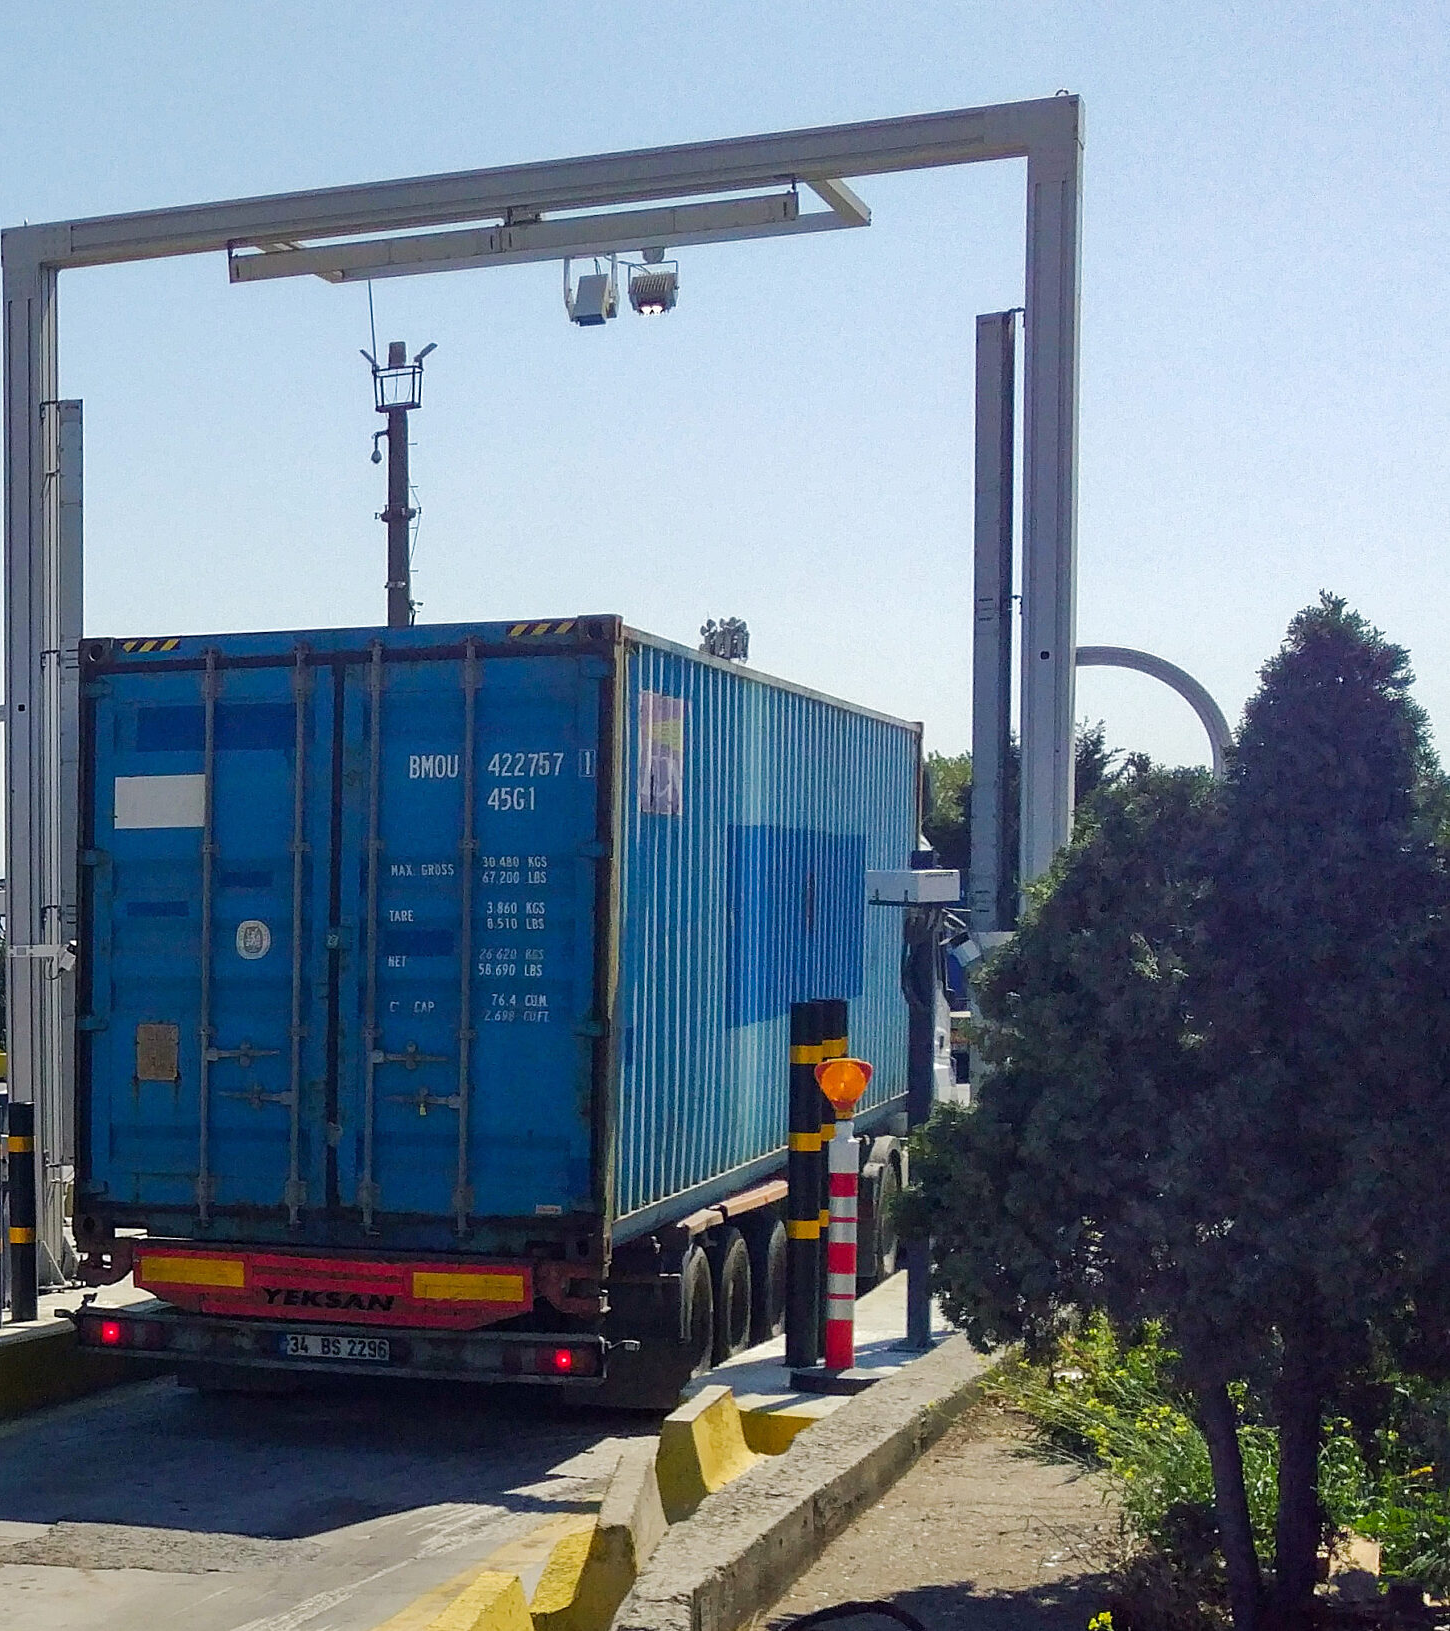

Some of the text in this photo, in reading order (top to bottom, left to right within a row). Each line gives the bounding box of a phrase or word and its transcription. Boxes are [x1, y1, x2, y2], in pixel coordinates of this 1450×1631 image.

[409, 754, 459, 779] BMOU
[487, 752, 564, 777] 422757
[487, 787, 535, 811] 45G1
[391, 864, 413, 876] MAX
[421, 863, 455, 876] GROSS
[528, 856, 548, 868] KGS
[527, 871, 548, 884] LBS
[389, 909, 414, 922] TARE
[525, 902, 546, 914] KGS
[526, 918, 545, 930] LBS
[388, 955, 407, 968] NET
[524, 964, 543, 977] LBS
[414, 1001, 435, 1013] CAP
[491, 993, 517, 1007] 76.4
[261, 1286, 395, 1311] YEKSAN
[290, 1336, 387, 1358] 34 BS 2296
